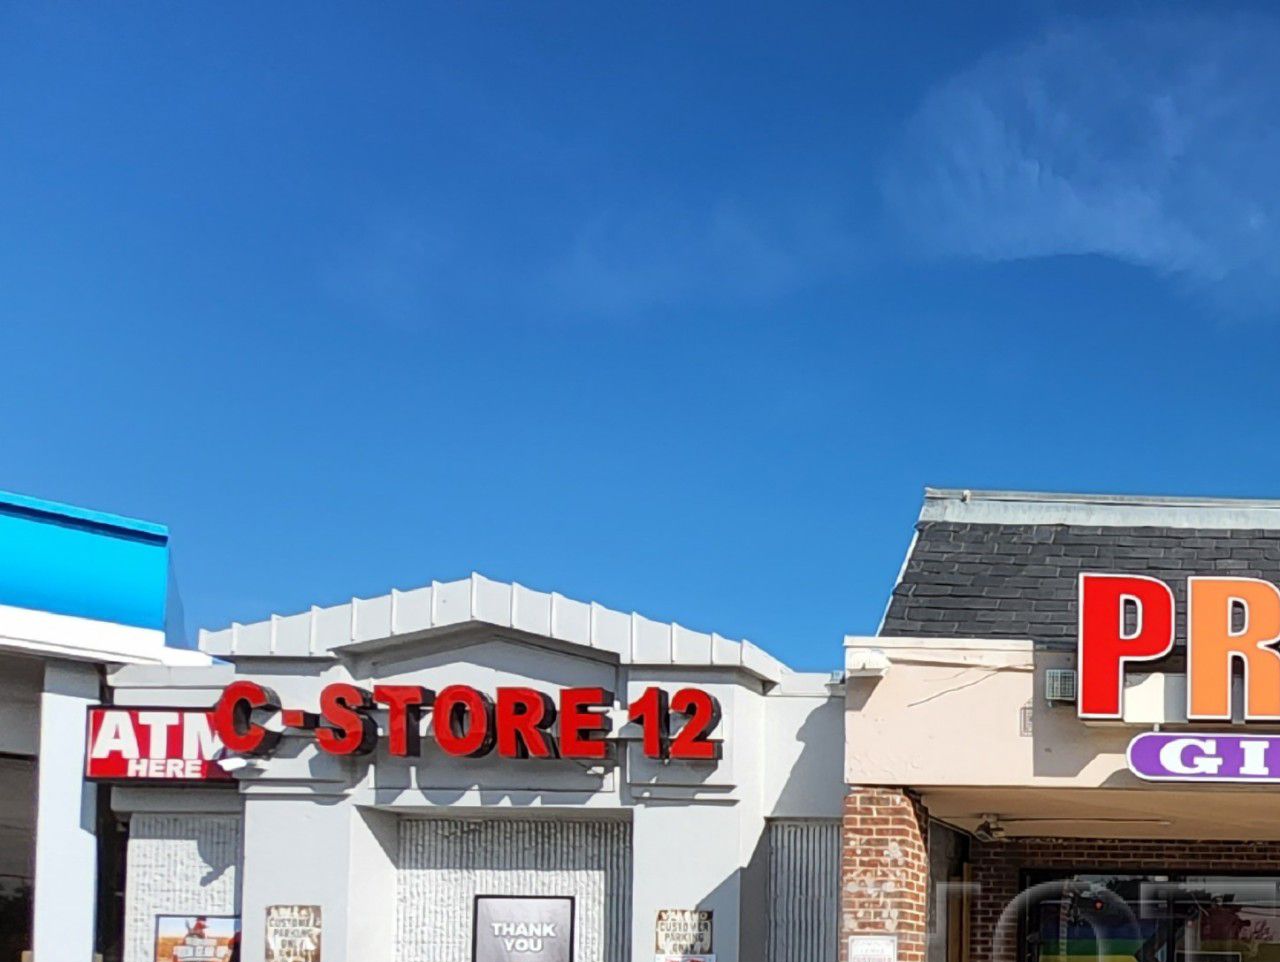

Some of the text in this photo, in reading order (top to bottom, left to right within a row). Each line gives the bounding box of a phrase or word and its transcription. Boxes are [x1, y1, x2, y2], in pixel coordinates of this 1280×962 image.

[215, 681, 716, 760] C-STORE 12
[92, 709, 224, 761] ATM
[127, 759, 202, 778] HERE
[491, 922, 556, 937] THANK
[504, 938, 543, 952] YOU
